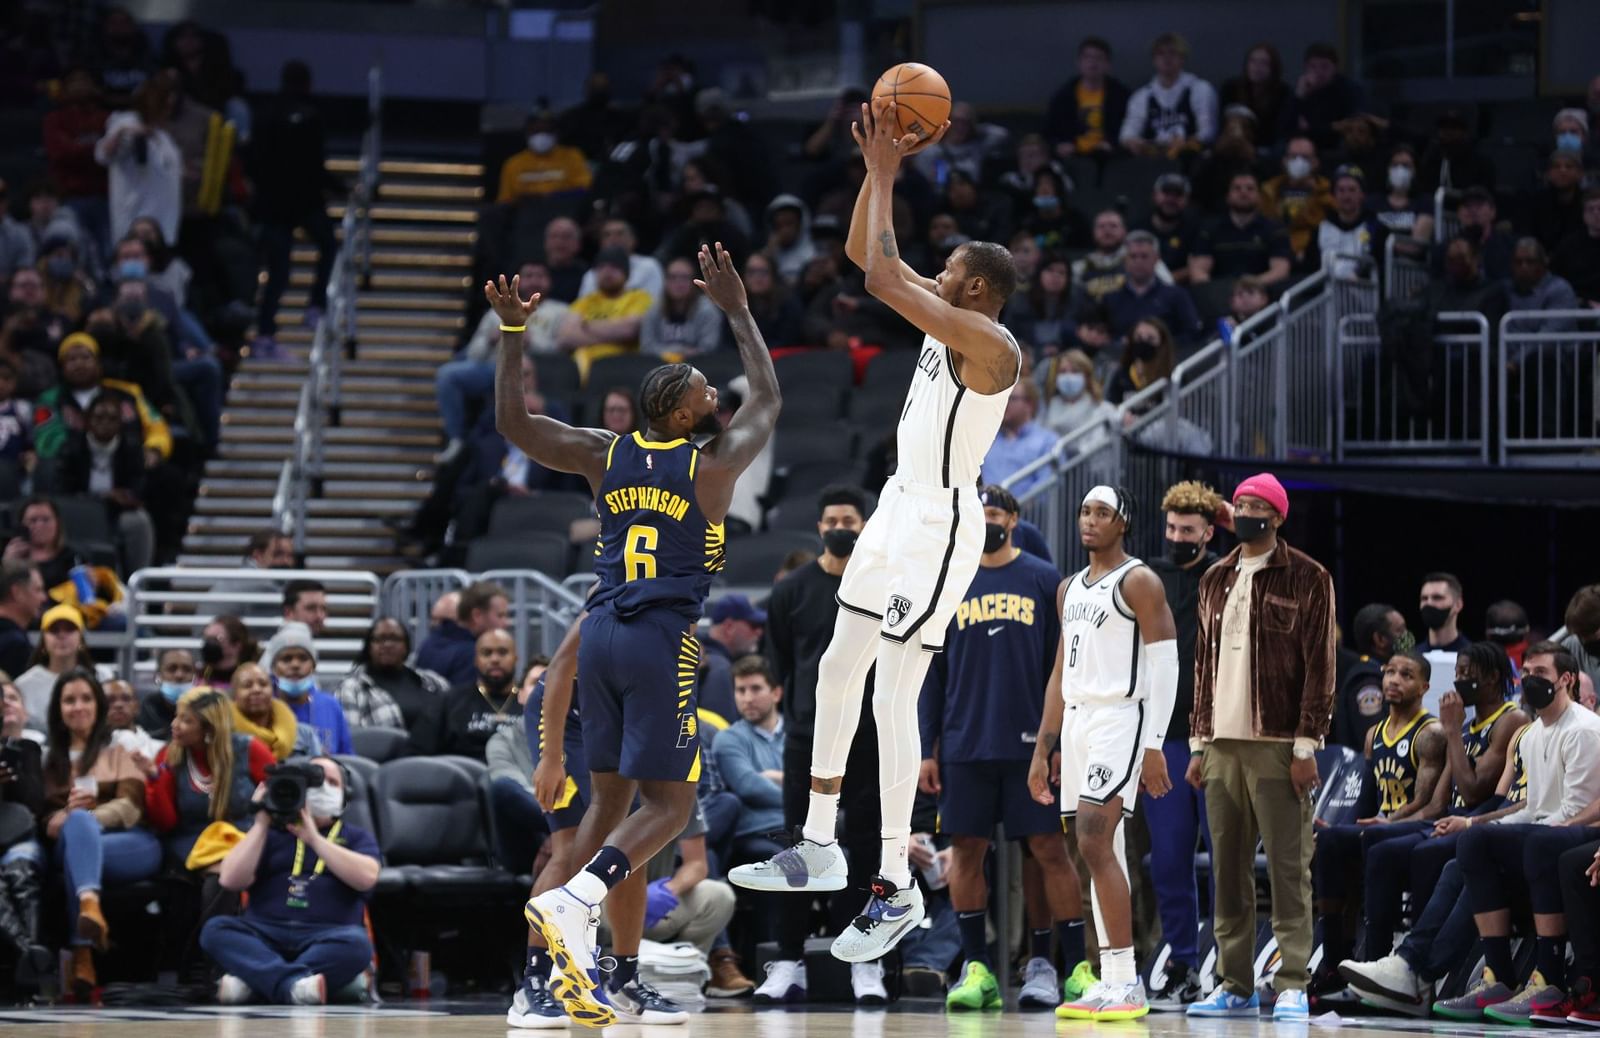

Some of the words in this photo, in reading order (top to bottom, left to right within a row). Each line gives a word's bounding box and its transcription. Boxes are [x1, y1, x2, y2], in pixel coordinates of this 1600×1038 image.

[604, 487, 690, 521] STEPHENSON
[624, 524, 658, 583] 6
[956, 593, 1036, 632] PACERS
[1069, 634, 1080, 668] 6
